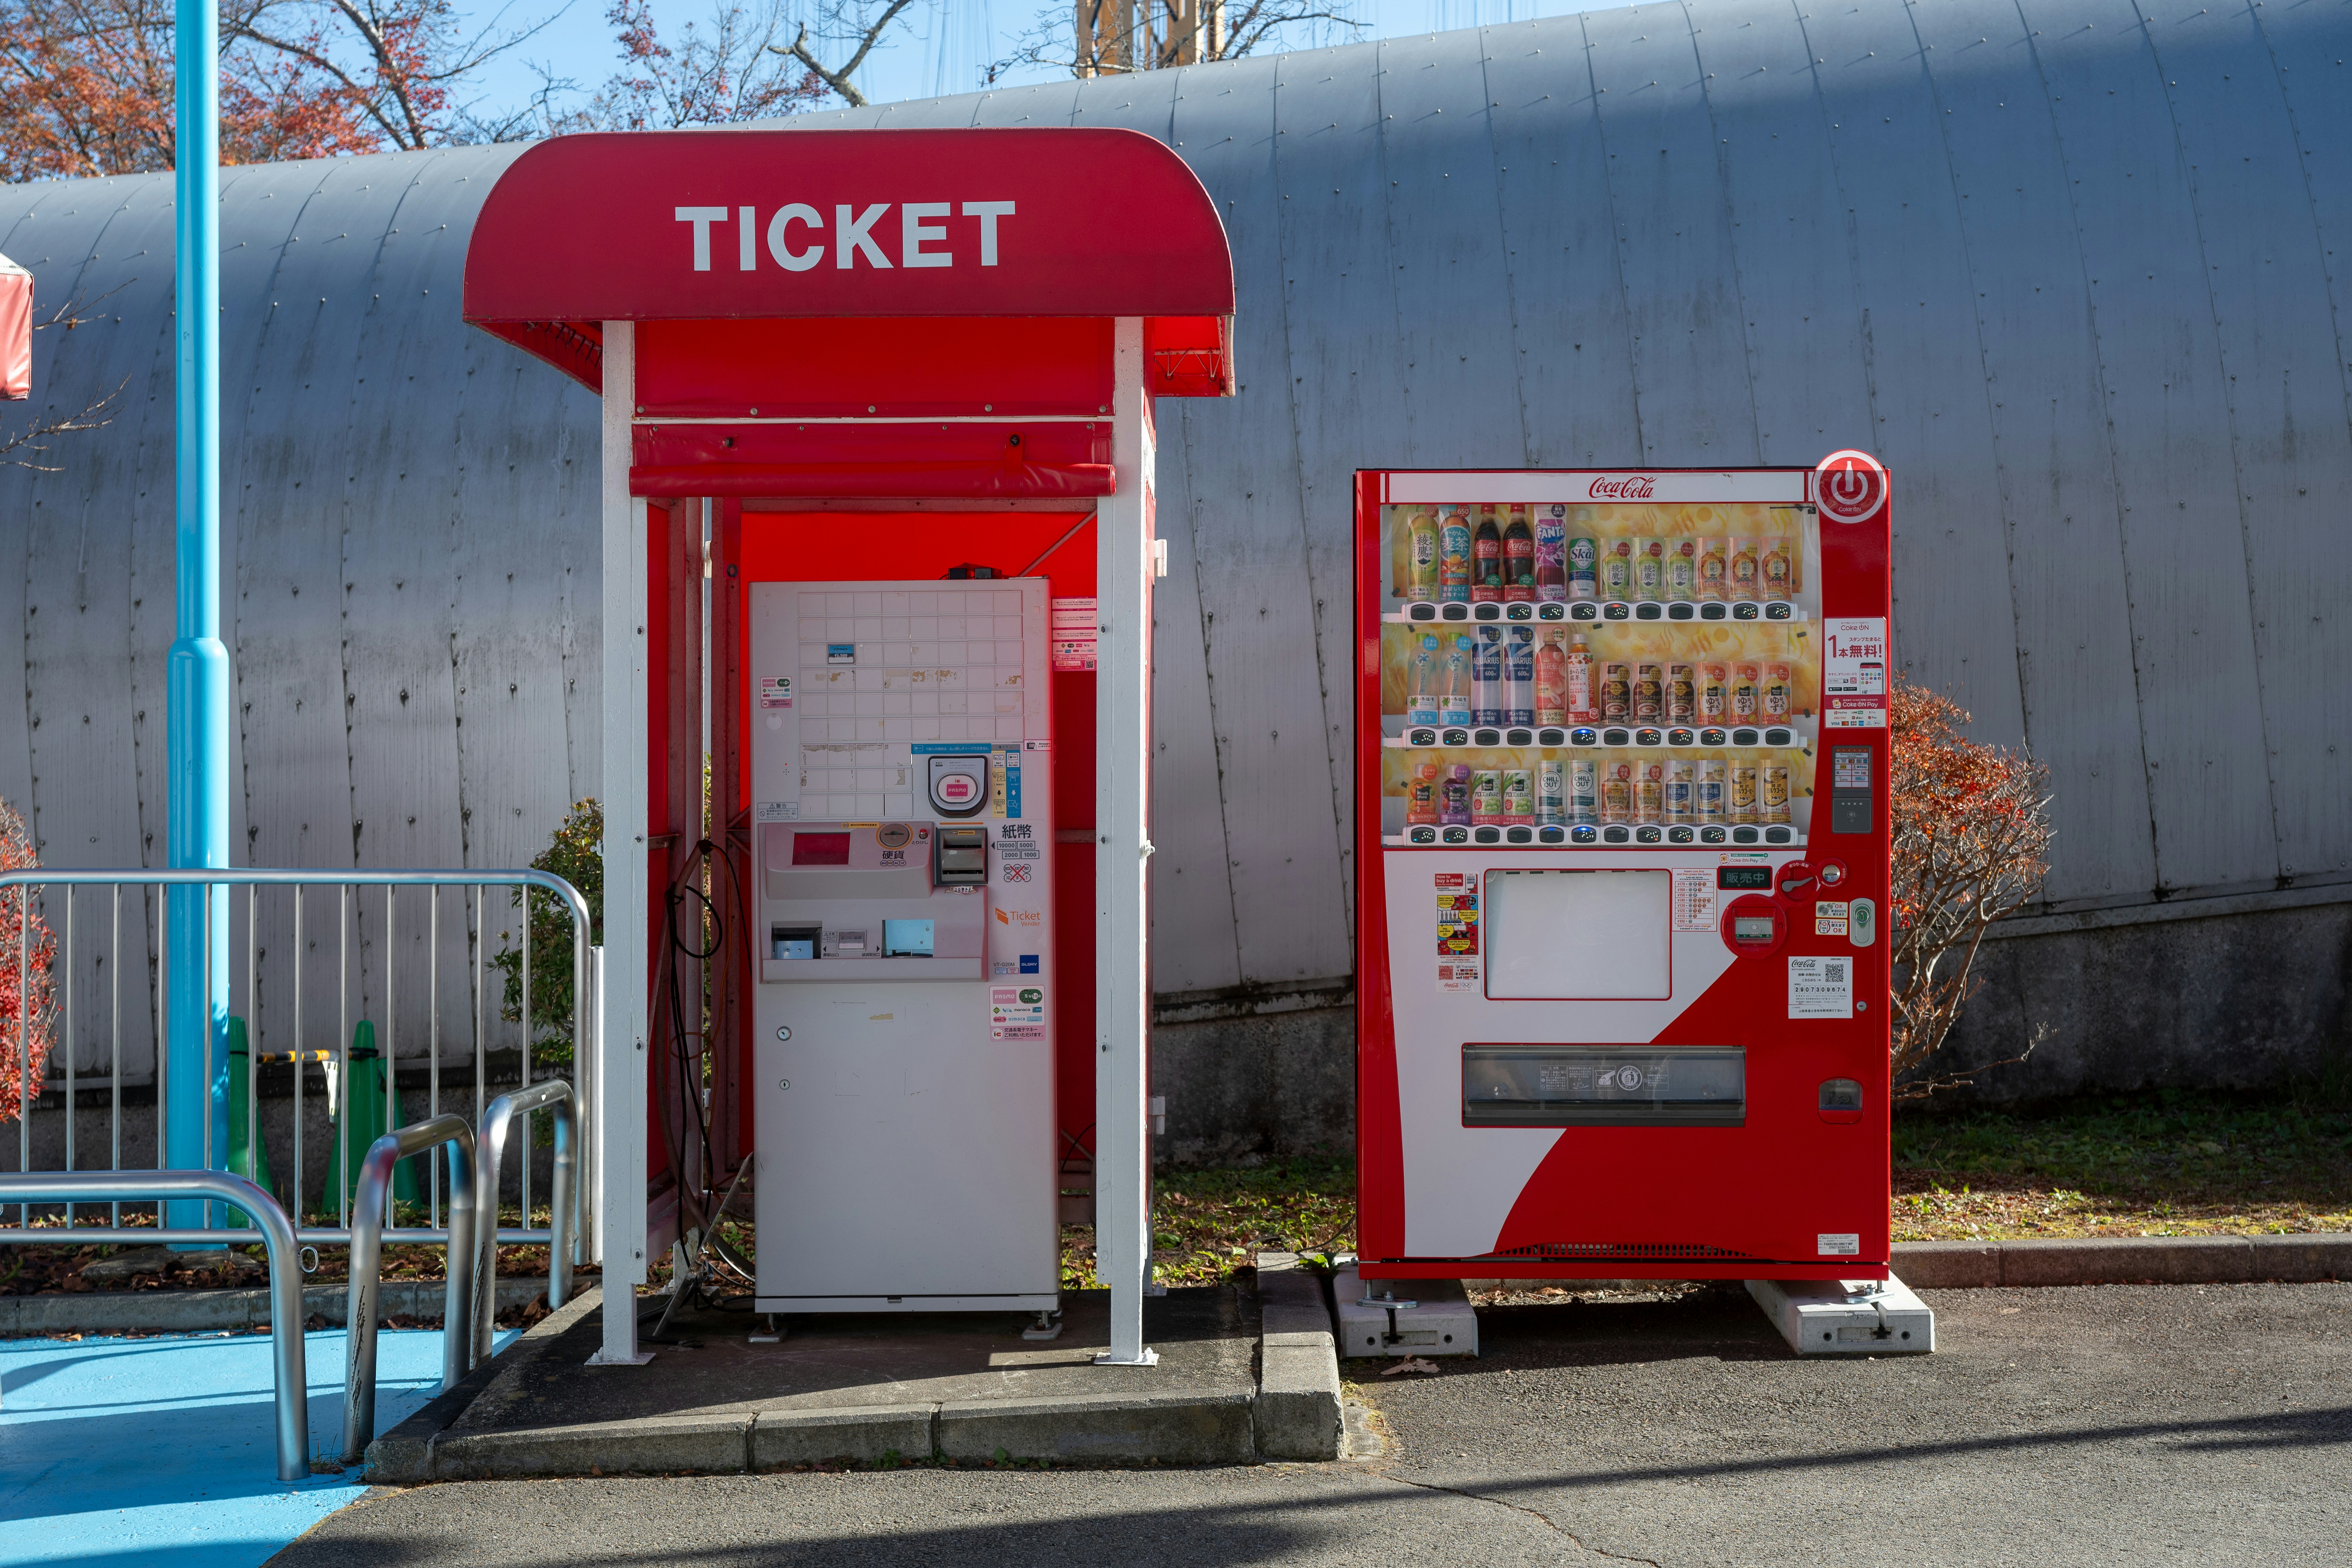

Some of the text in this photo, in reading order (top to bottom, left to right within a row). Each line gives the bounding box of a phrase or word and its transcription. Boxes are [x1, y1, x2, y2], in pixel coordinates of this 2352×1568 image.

[675, 200, 1015, 271] TICKET
[1589, 477, 1657, 498] Coca-Cola
[1537, 526, 1565, 539] FANTA
[1417, 534, 1430, 558] 綾鷹
[1442, 536, 1469, 552] 麦茶
[1475, 541, 1498, 552] Coca-Cola
[1706, 697, 1715, 713] ゆず
[1002, 824, 1032, 840] 紙幣
[882, 851, 904, 859] 硬貨
[1727, 873, 1764, 883] 販売中
[1010, 911, 1040, 920] Ticket
